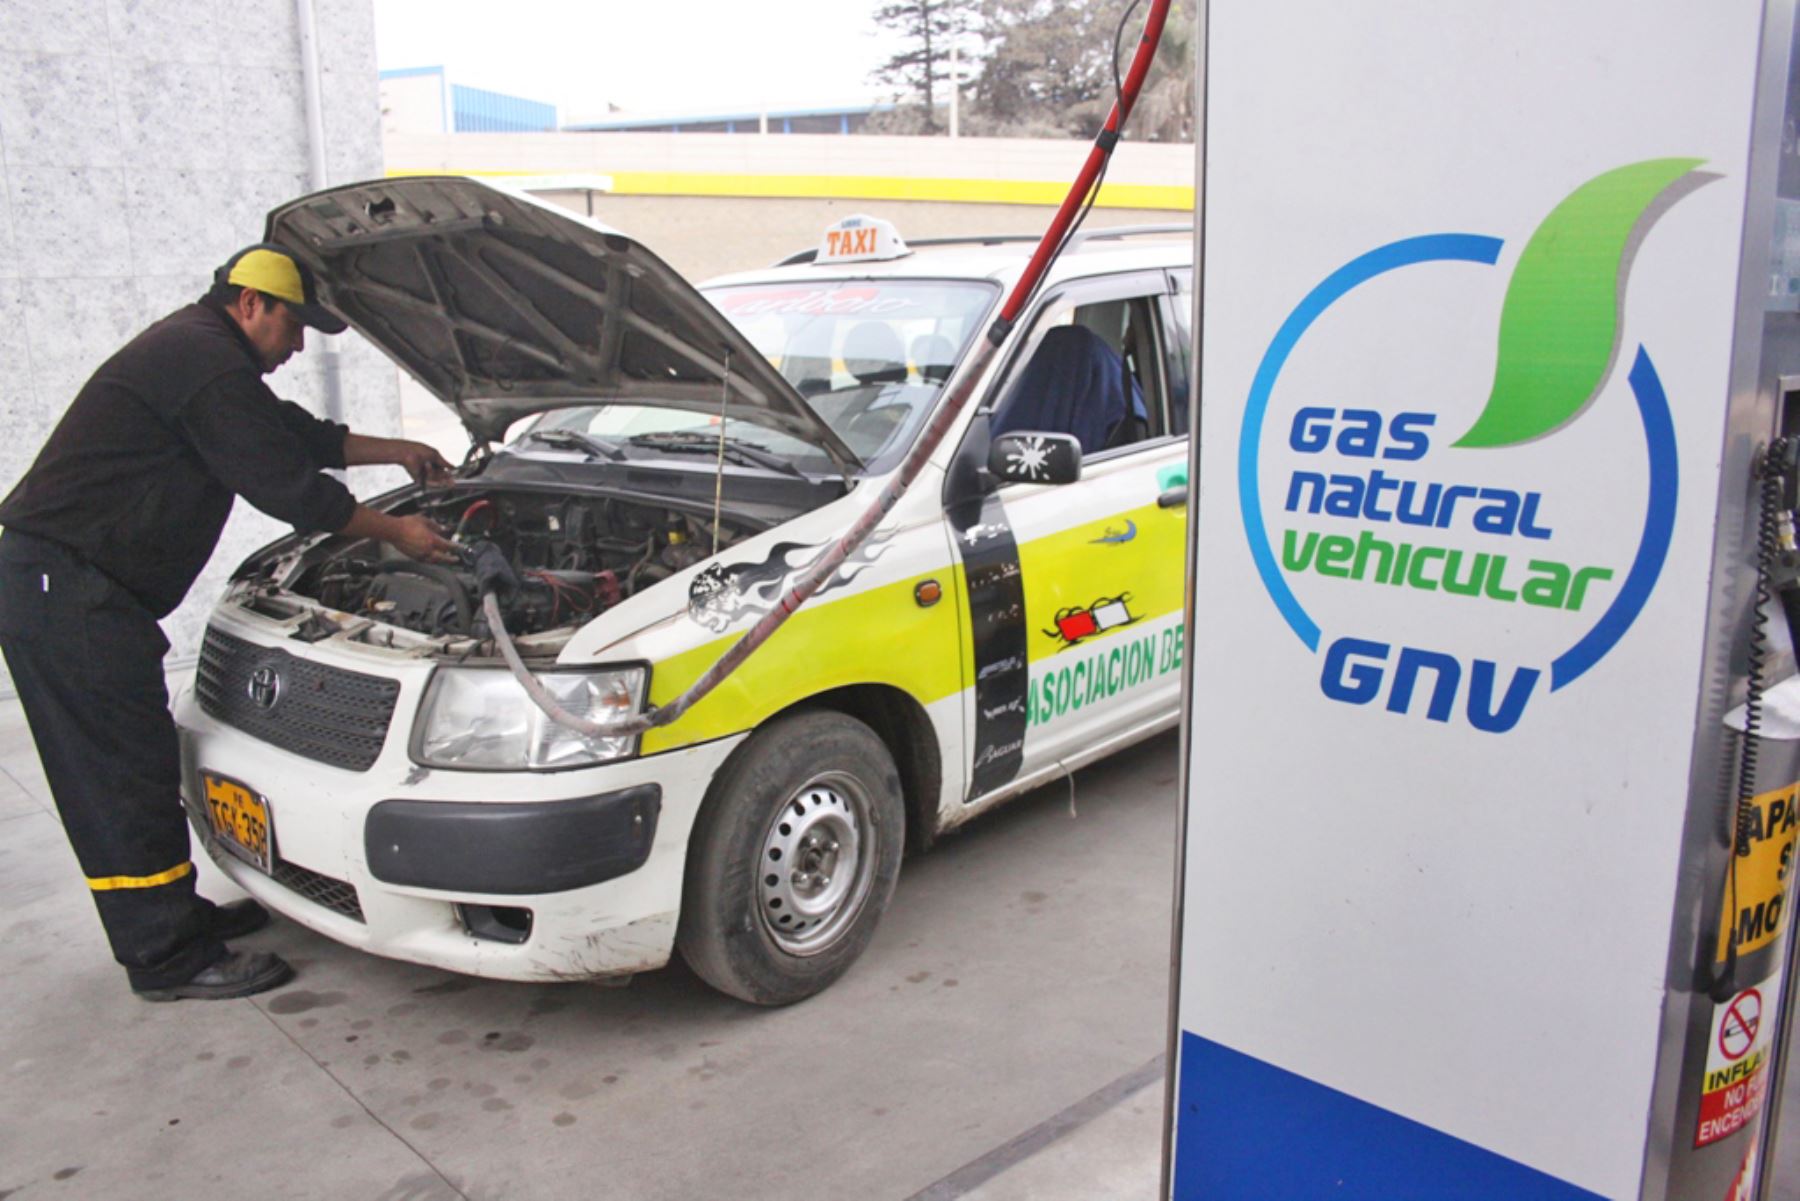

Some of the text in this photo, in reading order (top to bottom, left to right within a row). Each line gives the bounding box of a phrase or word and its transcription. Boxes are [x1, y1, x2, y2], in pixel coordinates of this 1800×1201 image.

[827, 228, 876, 256] TAXI
[1289, 407, 1436, 461] Gas
[1285, 469, 1552, 540] natural
[1281, 529, 1614, 611] vehicular
[1025, 634, 1155, 728] ASOCIACION
[1724, 1084, 1744, 1109] NO
